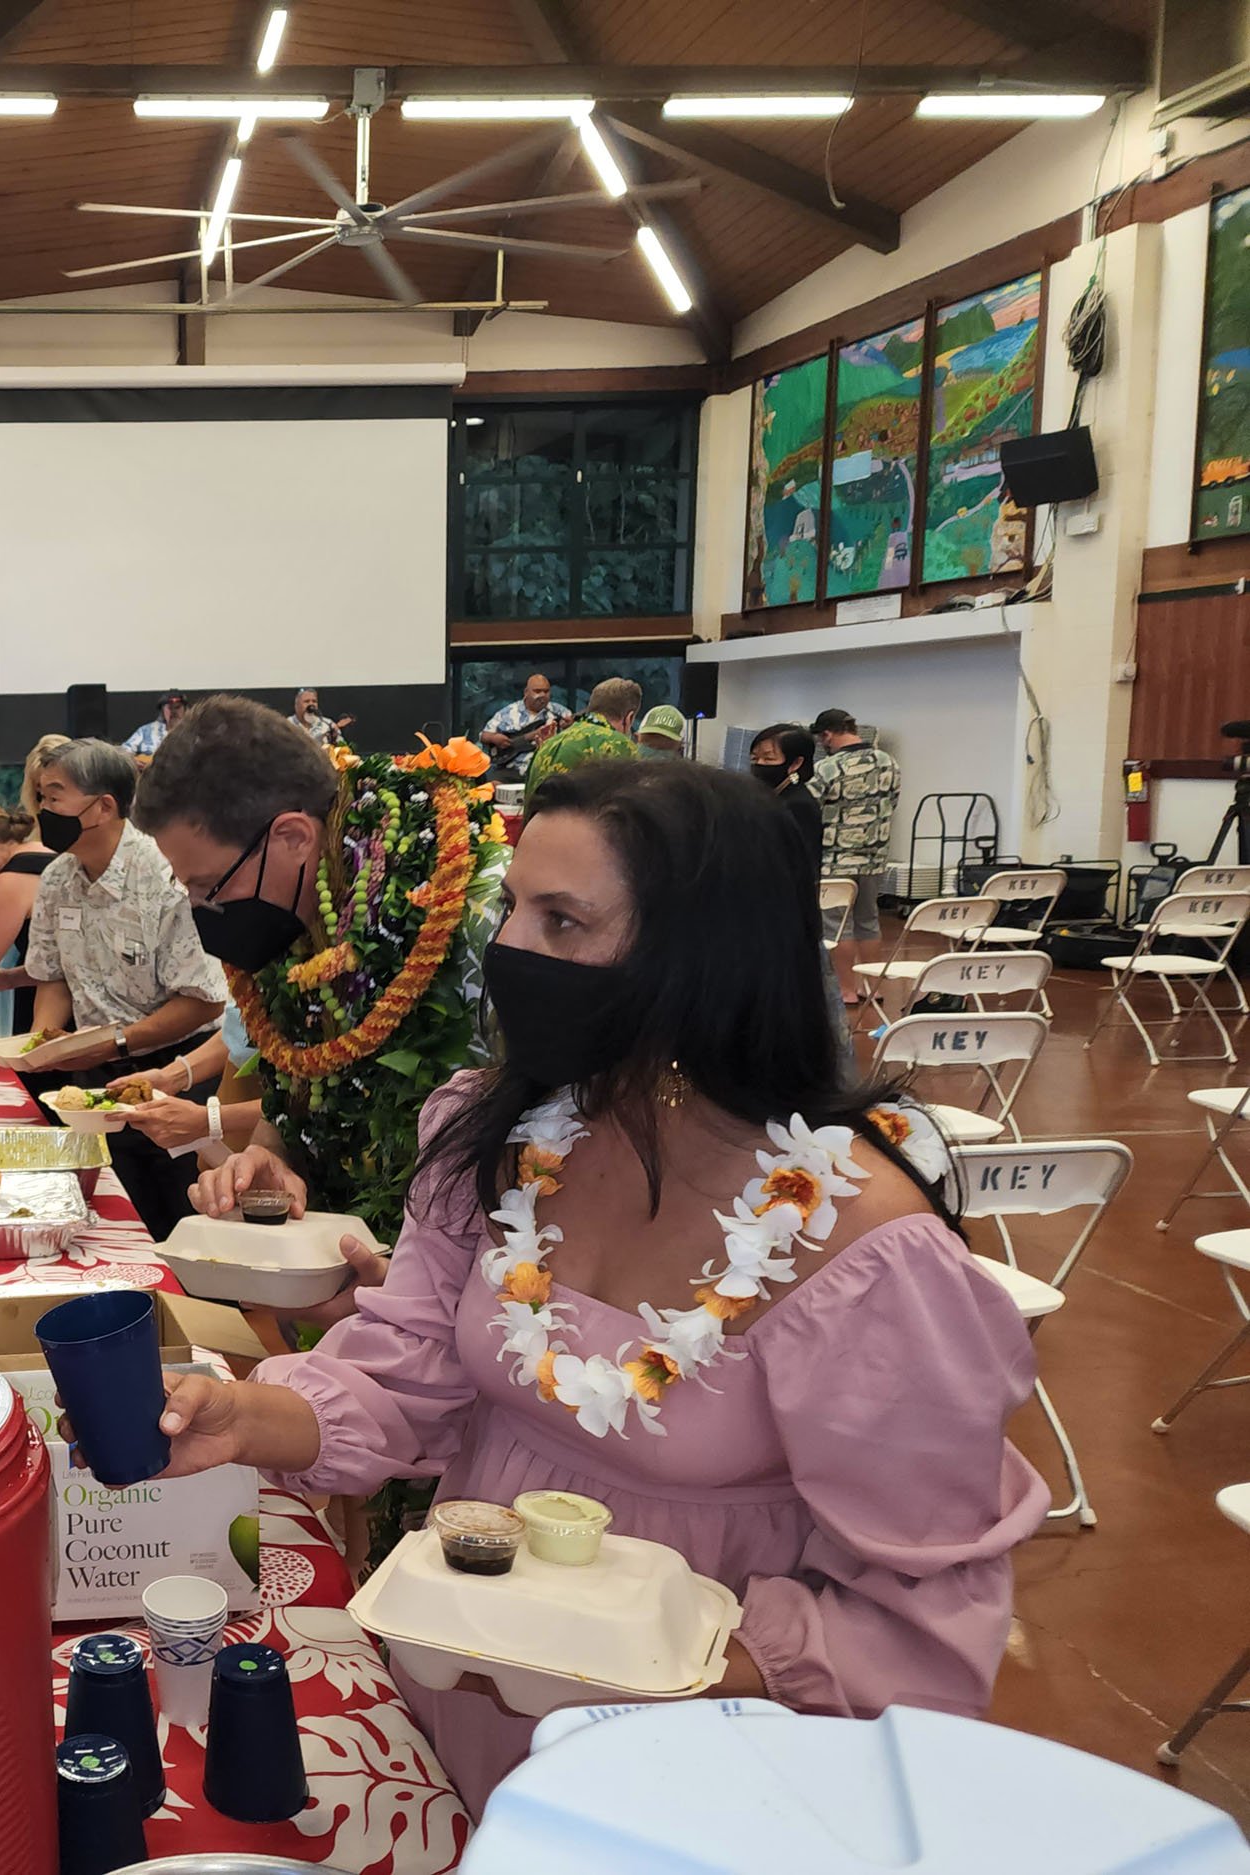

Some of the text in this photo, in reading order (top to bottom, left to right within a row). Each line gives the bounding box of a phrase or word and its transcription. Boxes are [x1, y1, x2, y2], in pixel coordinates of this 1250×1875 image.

[1008, 879, 1038, 891] KEY
[1204, 872, 1235, 884] KEY
[938, 907, 970, 921] KEY
[1189, 901, 1223, 914] KEY
[960, 964, 1005, 980] KEY
[932, 1031, 988, 1050] KEY
[980, 1164, 1057, 1191] KEY
[63, 1481, 162, 1512] Organic
[67, 1513, 123, 1536] Pure
[65, 1539, 171, 1563] Coconut
[67, 1566, 141, 1589] Water
